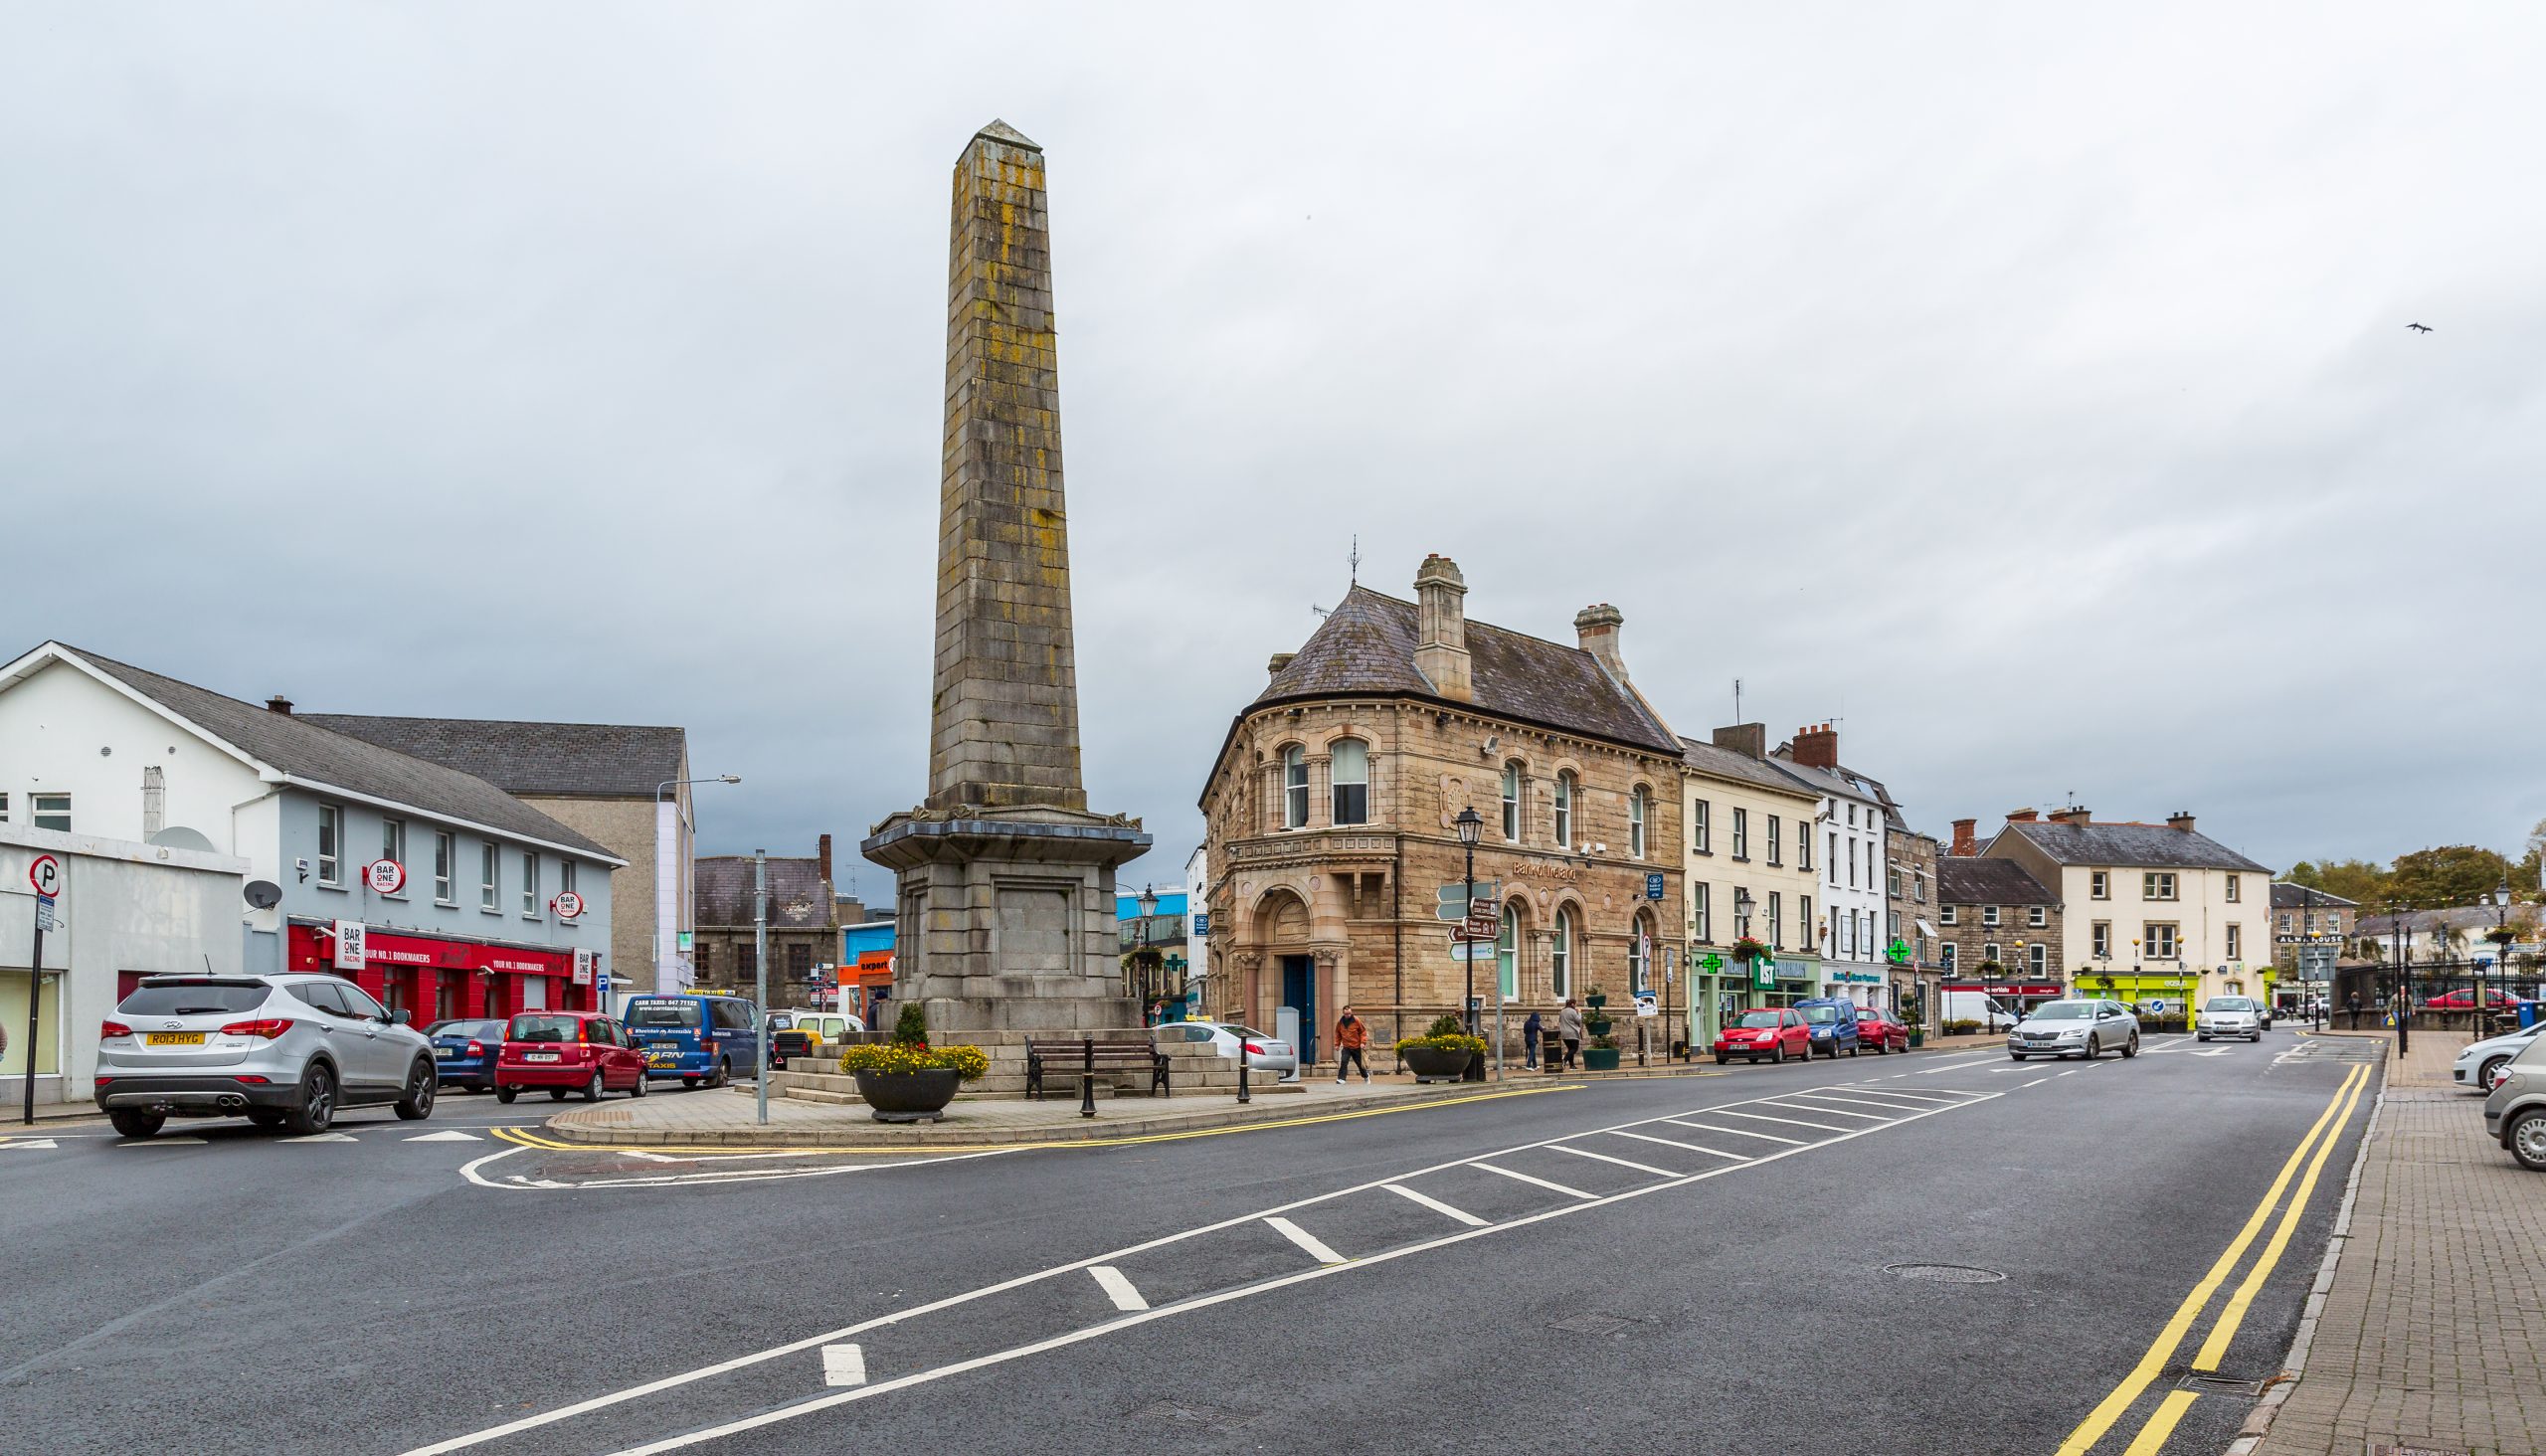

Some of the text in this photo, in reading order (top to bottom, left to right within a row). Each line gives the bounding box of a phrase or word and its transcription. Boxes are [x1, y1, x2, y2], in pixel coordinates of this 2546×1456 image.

[43, 863, 55, 887] P
[377, 865, 394, 874] BAR
[1513, 861, 1535, 875] Bank
[1546, 864, 1576, 880] Ireland
[344, 927, 360, 942] BAR
[344, 942, 360, 955] ONE
[344, 955, 360, 964] RACING
[365, 949, 377, 959] OUR
[393, 951, 431, 964] BOOKMAKERS
[579, 953, 589, 963] BAR
[493, 960, 505, 969] YOUR
[516, 962, 544, 972] BOOKMAKERS
[579, 964, 589, 974] ONE
[860, 961, 888, 971] expert
[1757, 957, 1774, 985] 1ST
[1775, 961, 1807, 979] PHARMACY
[598, 978, 608, 989] P
[178, 1033, 199, 1043] HYG
